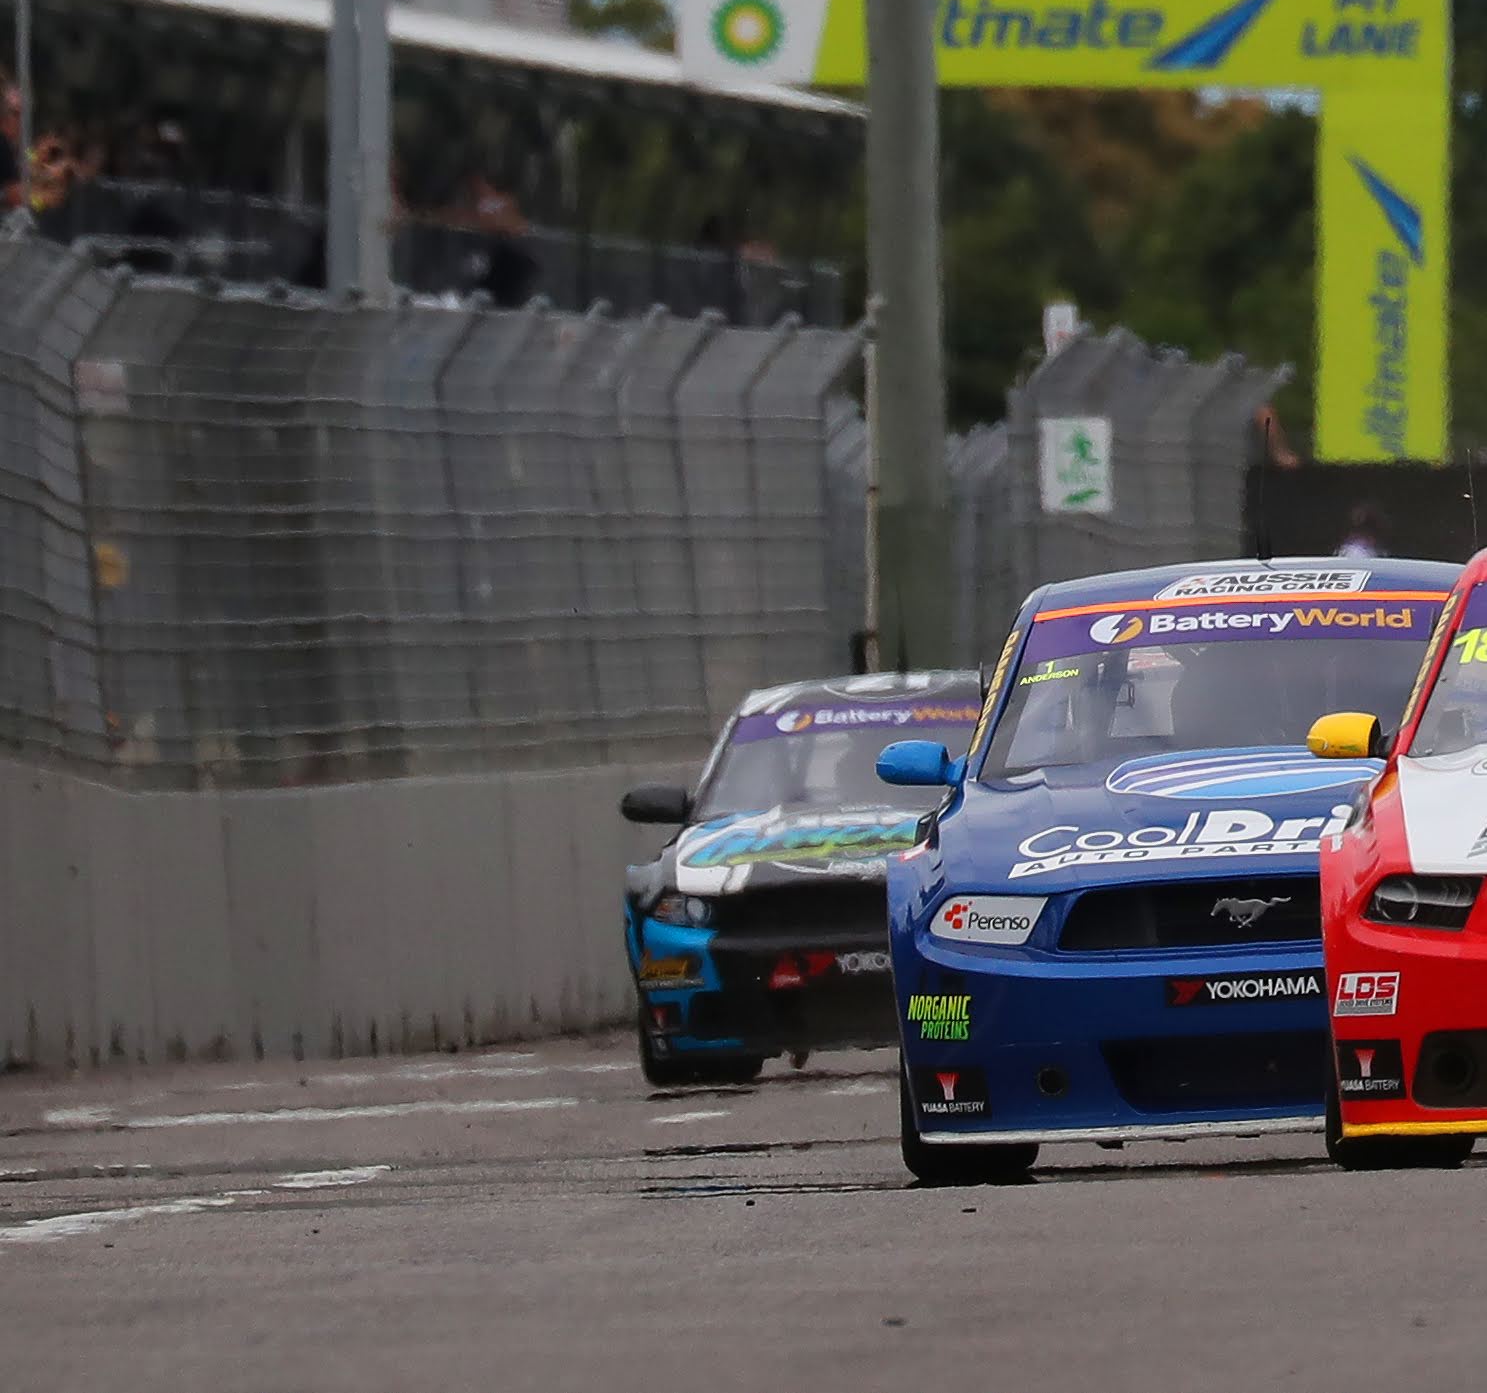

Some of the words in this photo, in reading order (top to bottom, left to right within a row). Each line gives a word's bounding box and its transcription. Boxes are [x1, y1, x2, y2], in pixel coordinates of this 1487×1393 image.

[1302, 19, 1419, 58] LANE
[1174, 584, 1275, 597] RACING
[1280, 581, 1351, 592] CARS
[1211, 572, 1355, 586] AUSSIE
[1020, 668, 1079, 686] ANDERSON
[1045, 660, 1056, 673] 1
[1018, 804, 1355, 858] CoolDri
[1022, 850, 1150, 874] AUTO
[1181, 841, 1321, 856] PART
[968, 912, 1030, 931] Perenso
[835, 952, 892, 974] YOKO
[1205, 975, 1321, 1000] YOKOHAMA
[1337, 976, 1397, 1000] LDS
[908, 994, 972, 1021] NORGANIC
[920, 1020, 970, 1041] PROTEINS
[1365, 1079, 1400, 1091] BATTERY
[921, 1102, 948, 1113] YUASA
[949, 1101, 985, 1113] BATTERY
